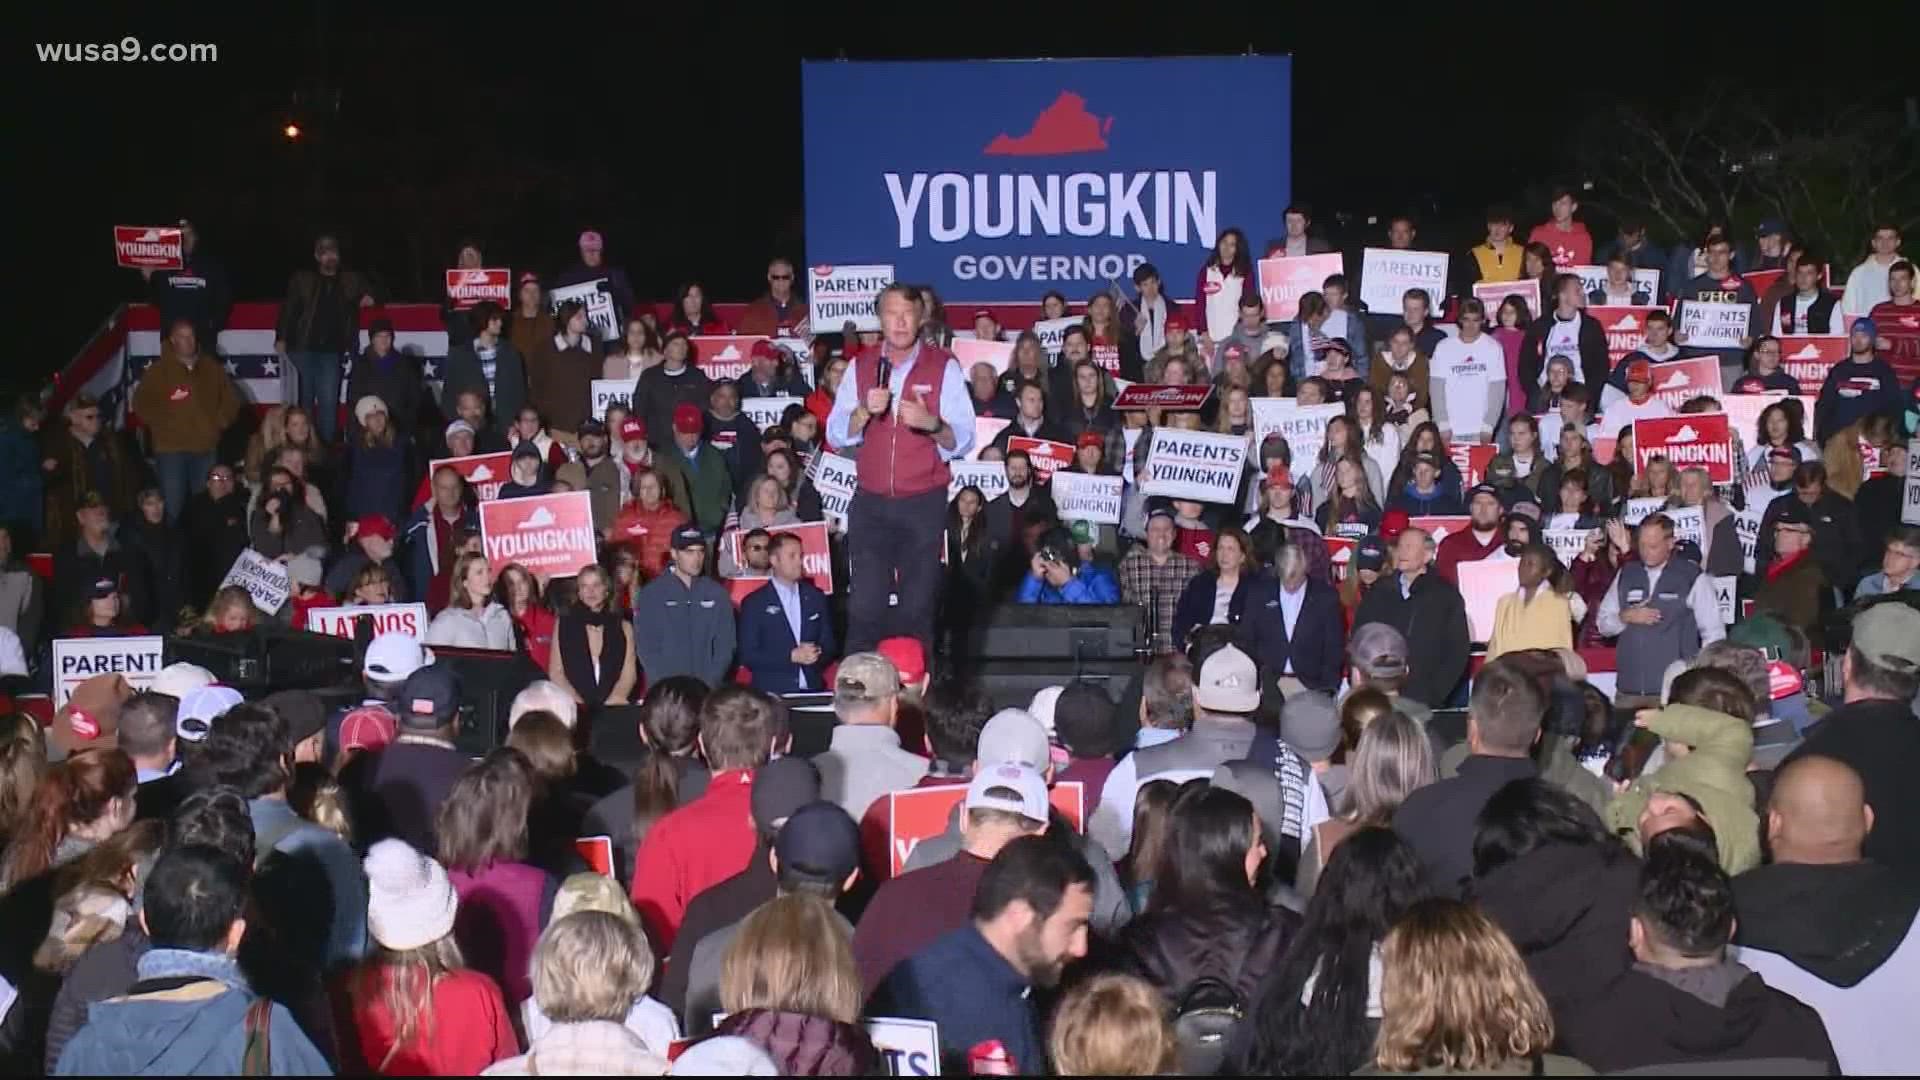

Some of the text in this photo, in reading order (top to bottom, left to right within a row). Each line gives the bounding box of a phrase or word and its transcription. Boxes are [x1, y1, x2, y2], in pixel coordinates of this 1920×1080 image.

[884, 171, 1216, 250] YOUNGKIN
[118, 242, 181, 258] YOUNGKIN
[953, 254, 1147, 281] GOVERNOR
[450, 285, 507, 299] YOUNGKIN
[814, 276, 889, 294] PARENTS
[816, 299, 877, 320] YOUNGK
[1685, 308, 1747, 322] PANTS
[1124, 391, 1205, 403] YOUNGKIN
[1155, 439, 1242, 462] PARENTS
[1151, 463, 1235, 490] YOUNGKIN
[488, 526, 592, 561] YOUNGKIN
[319, 613, 417, 640] LATNOS
[62, 653, 159, 675] PARENT
